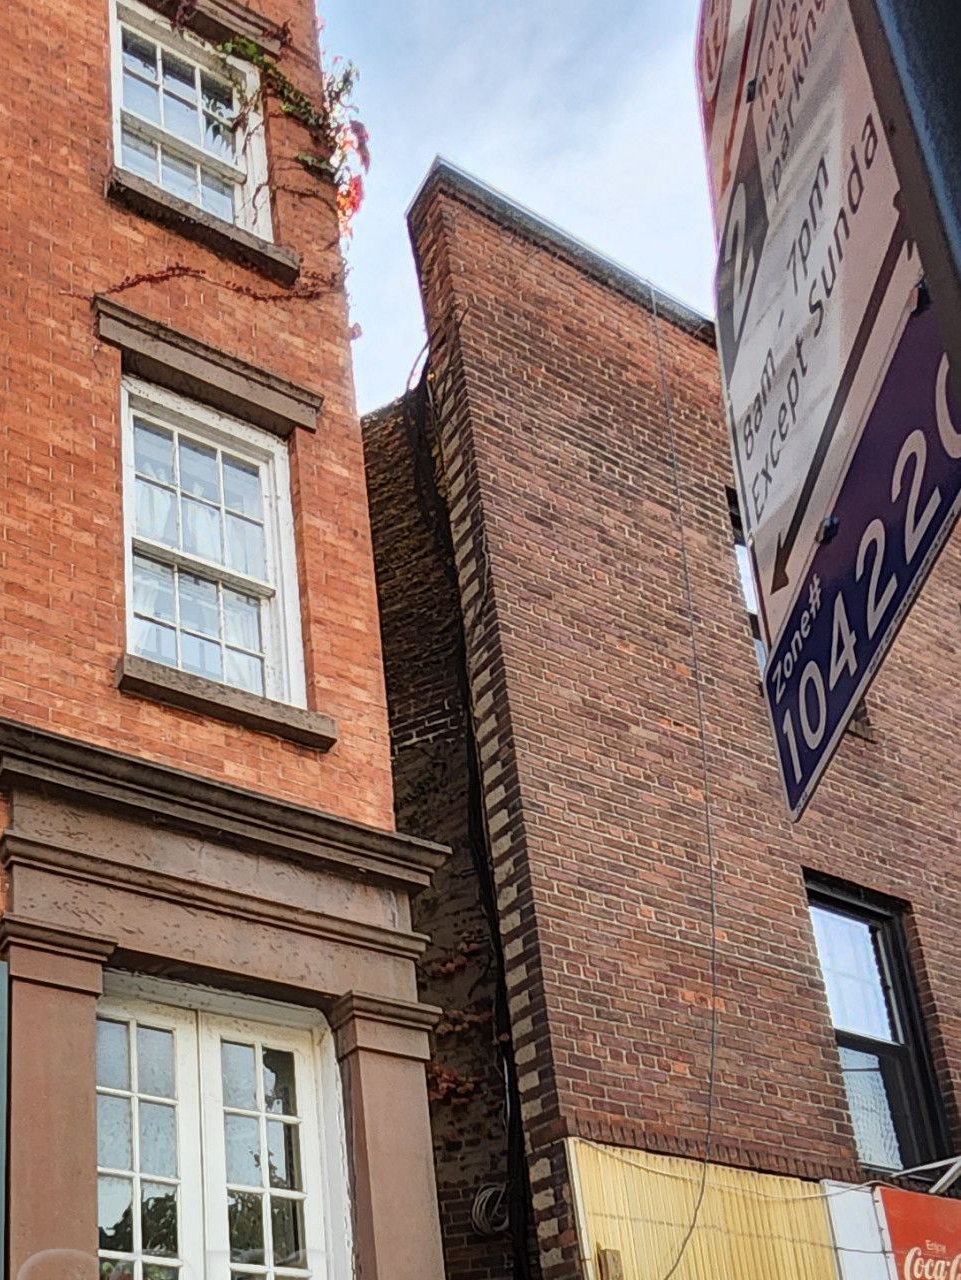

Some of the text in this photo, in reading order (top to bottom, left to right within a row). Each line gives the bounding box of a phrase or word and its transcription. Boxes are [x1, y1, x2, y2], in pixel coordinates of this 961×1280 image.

[765, 0, 804, 151] mete
[741, 347, 776, 461] 8am
[787, 156, 829, 296] 7pm
[749, 112, 879, 522] Except Sunda
